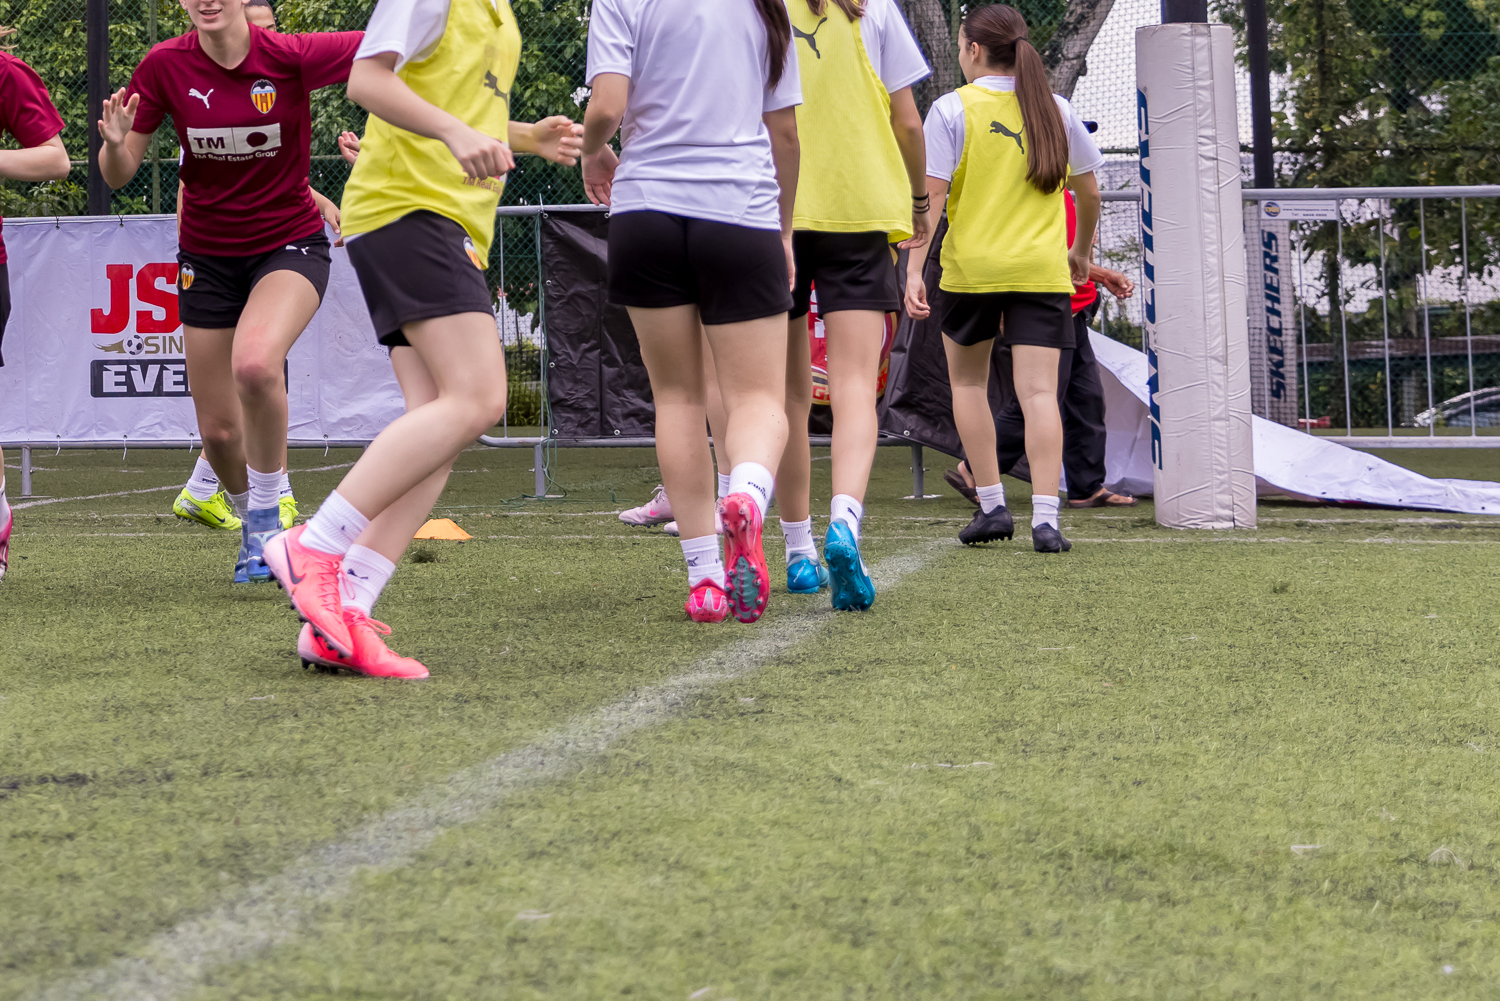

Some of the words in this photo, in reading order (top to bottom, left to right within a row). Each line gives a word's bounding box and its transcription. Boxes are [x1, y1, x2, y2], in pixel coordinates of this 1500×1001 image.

[193, 136, 226, 149] TM
[227, 154, 254, 162] Estate
[1261, 229, 1287, 403] SKECHERS
